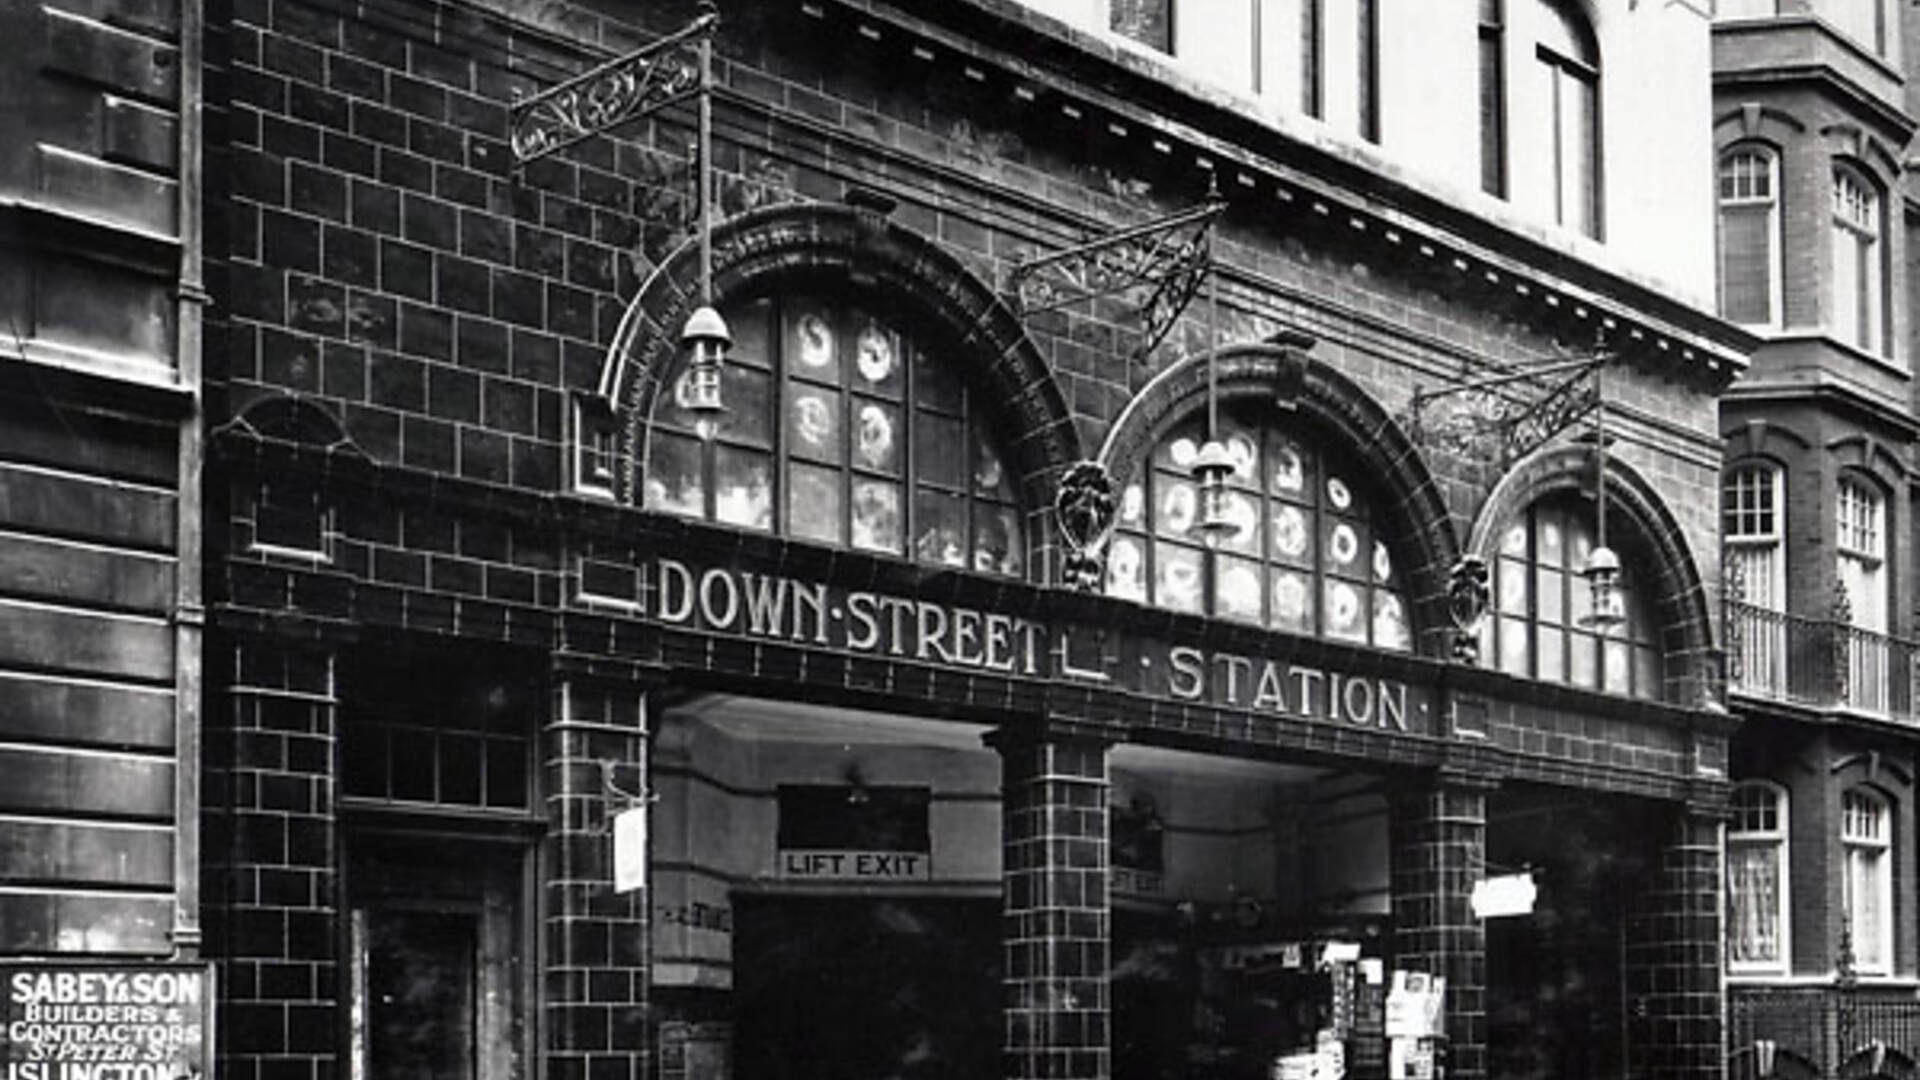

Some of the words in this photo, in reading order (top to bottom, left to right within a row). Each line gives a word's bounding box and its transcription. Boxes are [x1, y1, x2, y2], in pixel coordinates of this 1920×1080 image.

[657, 559, 830, 644] DOWN
[845, 591, 1045, 674] STREET
[1168, 646, 1408, 732] STATION
[787, 853, 845, 875] LIFT
[856, 855, 919, 877] EXIT
[130, 972, 200, 1004] SON
[25, 1002, 158, 1023] BUILDERS
[165, 1008, 182, 1023] &
[9, 1021, 201, 1043] CONTRACTORS
